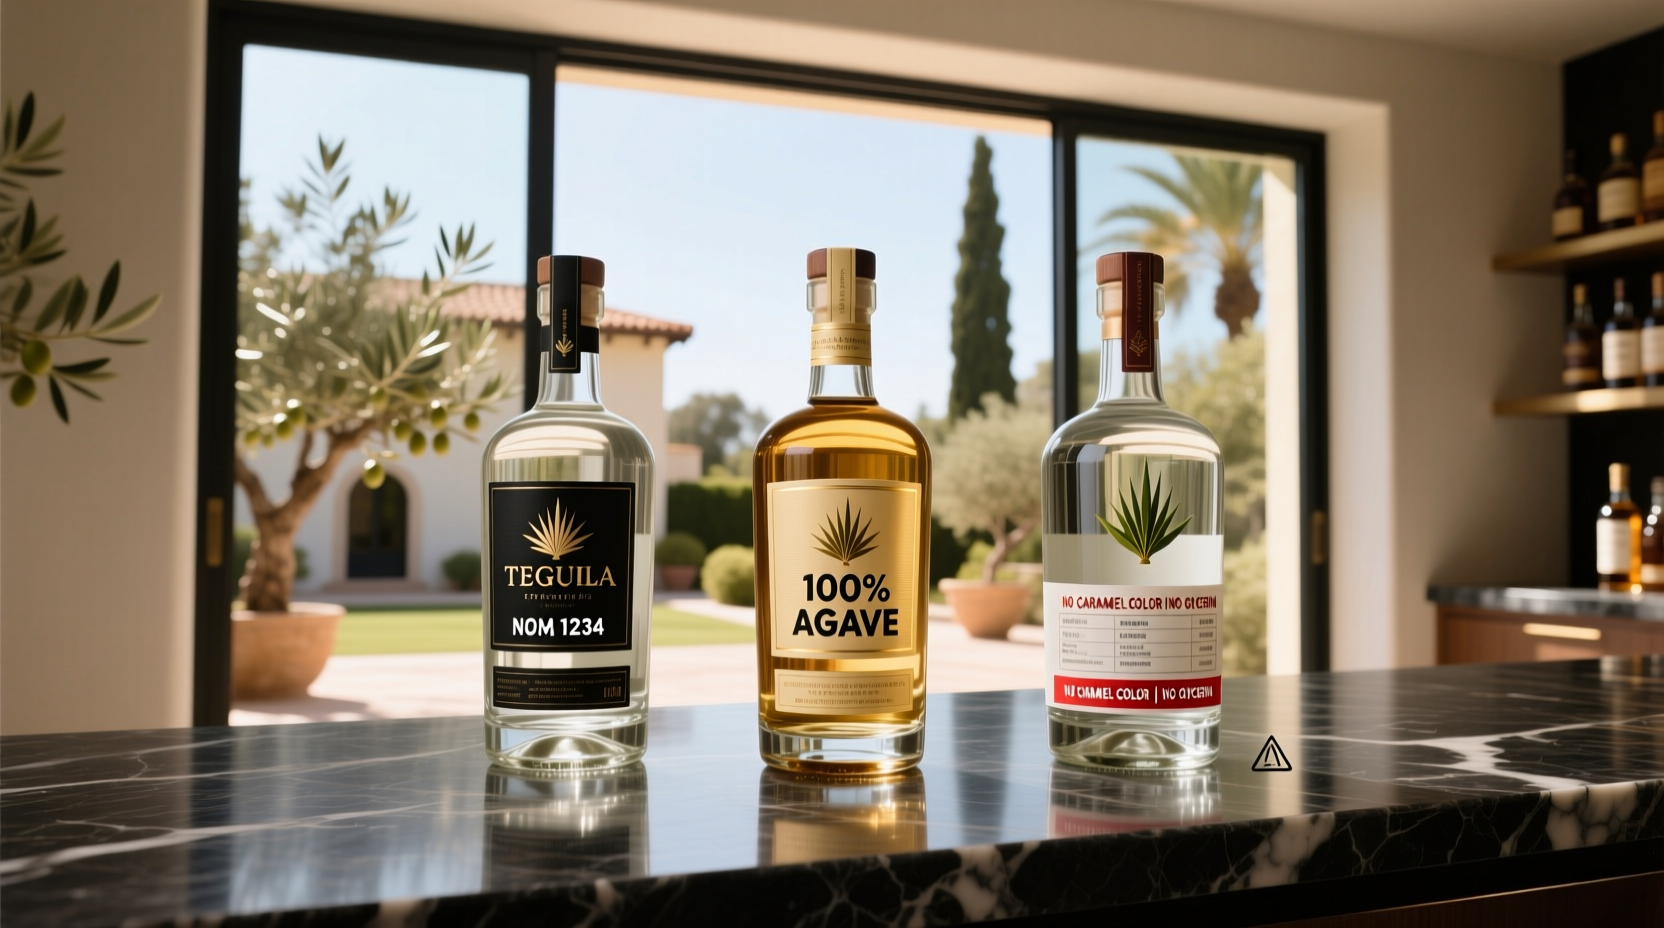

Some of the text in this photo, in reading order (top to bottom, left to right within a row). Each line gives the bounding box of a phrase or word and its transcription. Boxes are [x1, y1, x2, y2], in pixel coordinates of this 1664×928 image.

[802, 573, 890, 602] 100%
[1128, 597, 1162, 610] COLOR
[1168, 596, 1182, 610] NO
[512, 617, 604, 636] NOM 1234
[792, 608, 899, 637] AGAVE
[1116, 687, 1149, 701] COLOR
